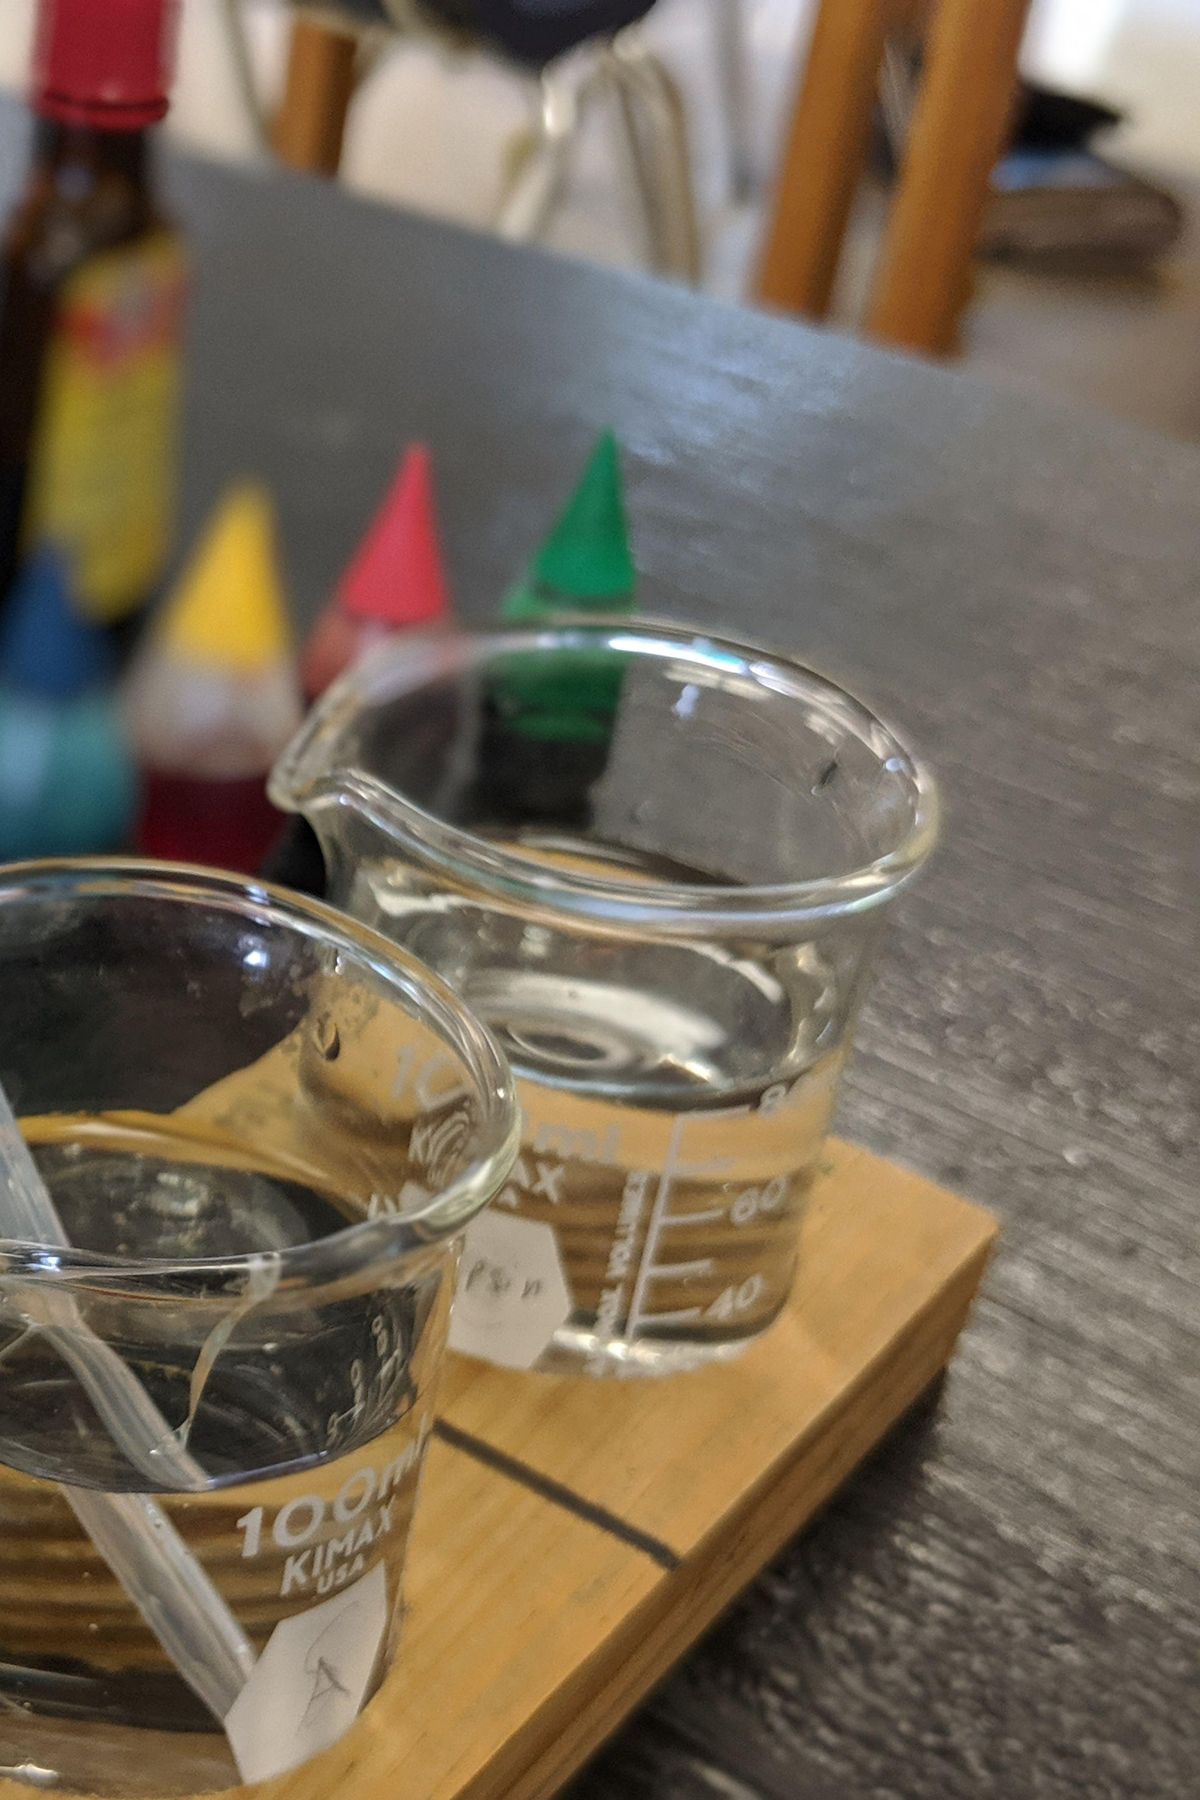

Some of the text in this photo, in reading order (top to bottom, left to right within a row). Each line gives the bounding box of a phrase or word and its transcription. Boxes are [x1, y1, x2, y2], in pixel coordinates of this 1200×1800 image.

[730, 1174, 788, 1226] 60
[703, 1271, 766, 1321] 40
[280, 1494, 397, 1597] KIMAX
[317, 1553, 364, 1594] USA
